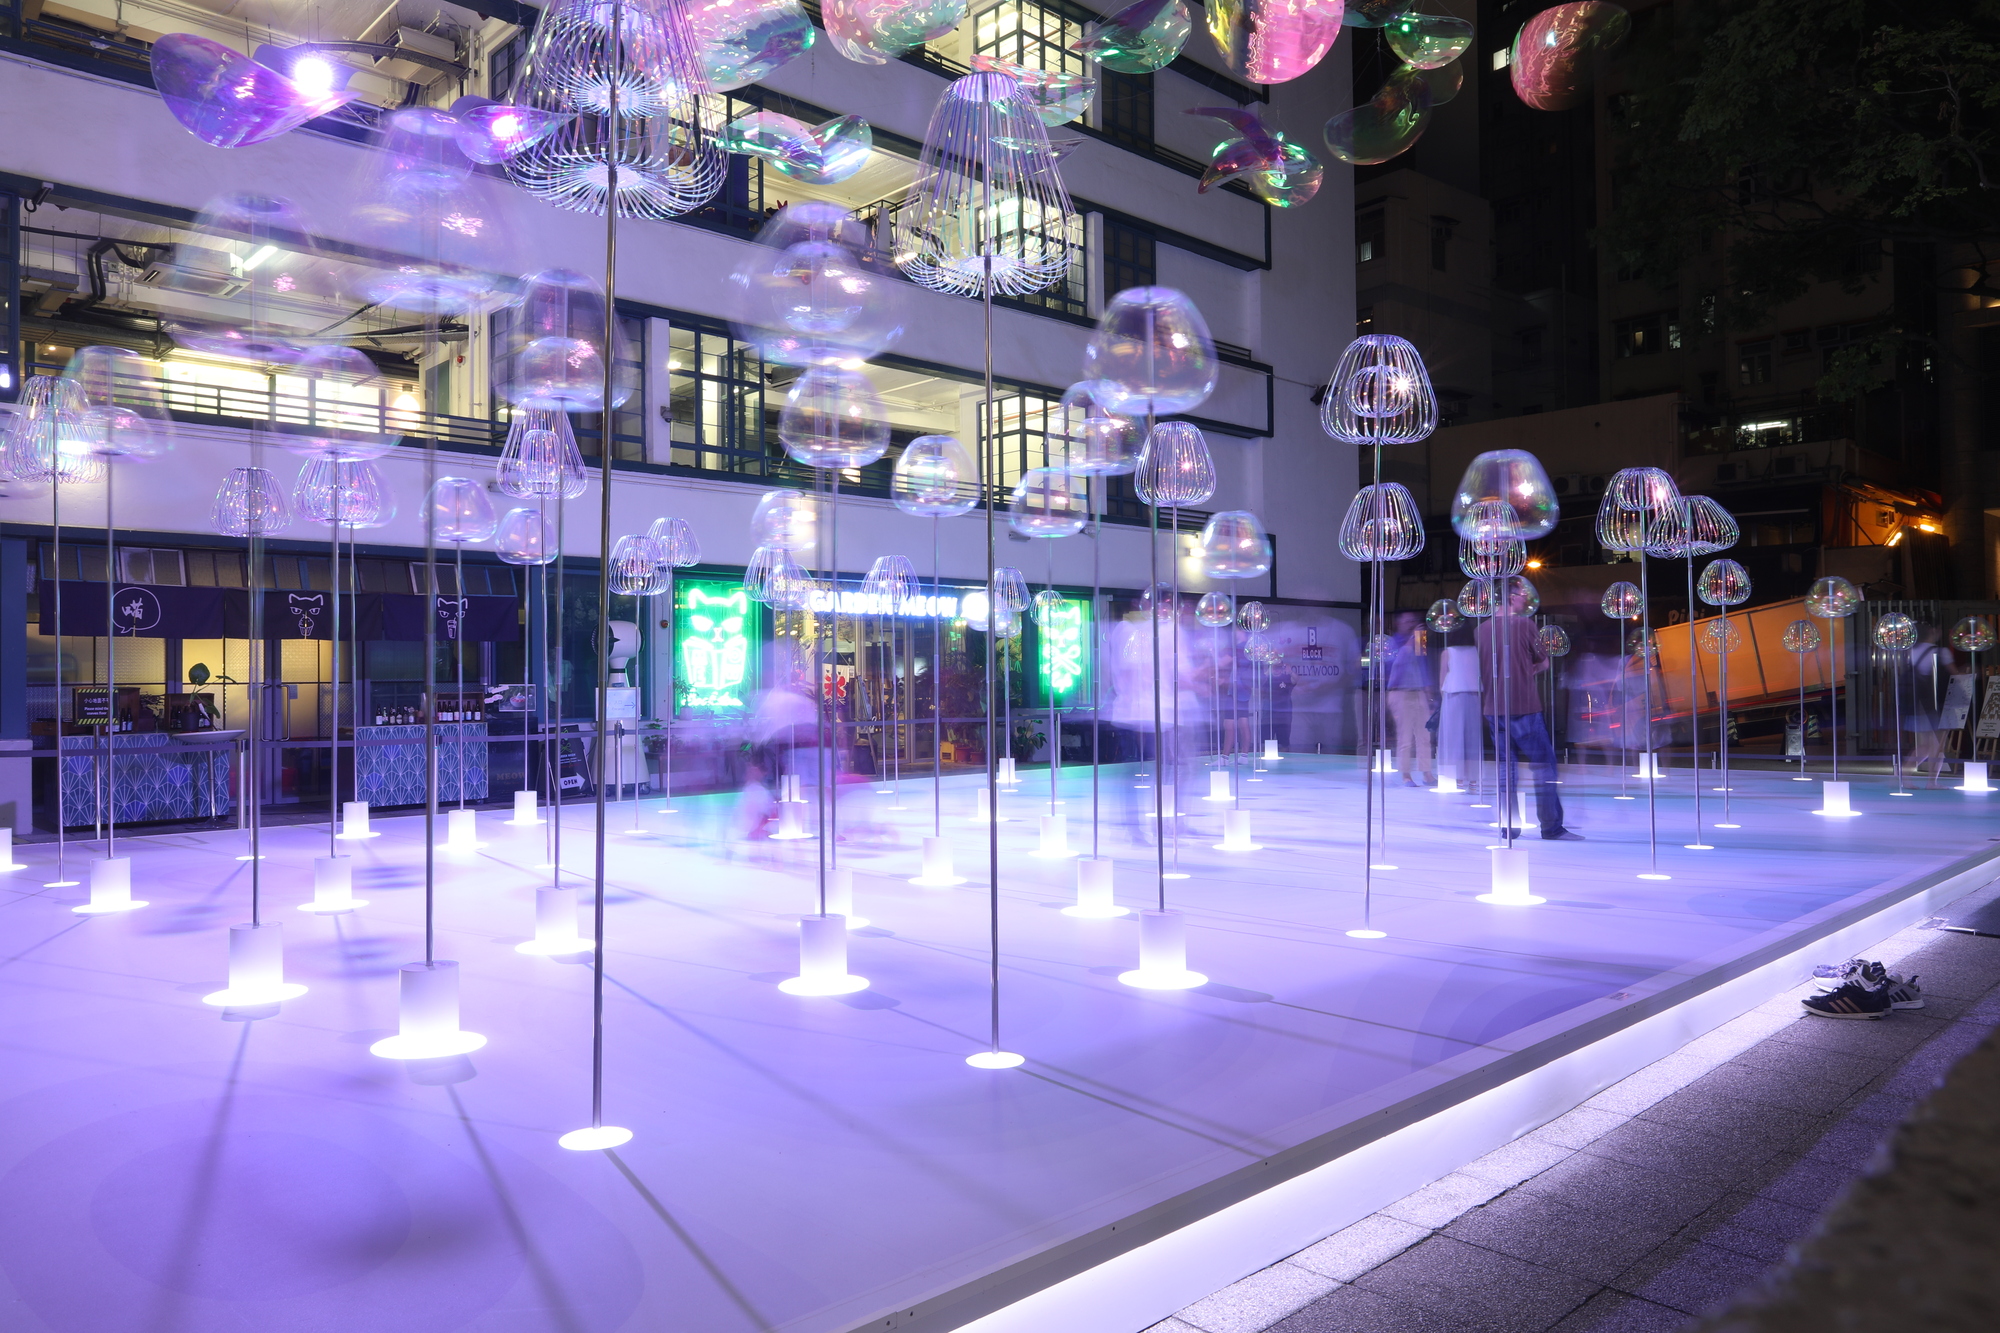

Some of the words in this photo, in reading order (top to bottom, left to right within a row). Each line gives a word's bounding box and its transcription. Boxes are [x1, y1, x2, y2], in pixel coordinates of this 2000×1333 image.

[898, 595, 958, 618] MEOW
[1309, 629, 1316, 646] B
[1302, 649, 1322, 659] BLOCK
[1286, 665, 1340, 676] OLLYWOOD
